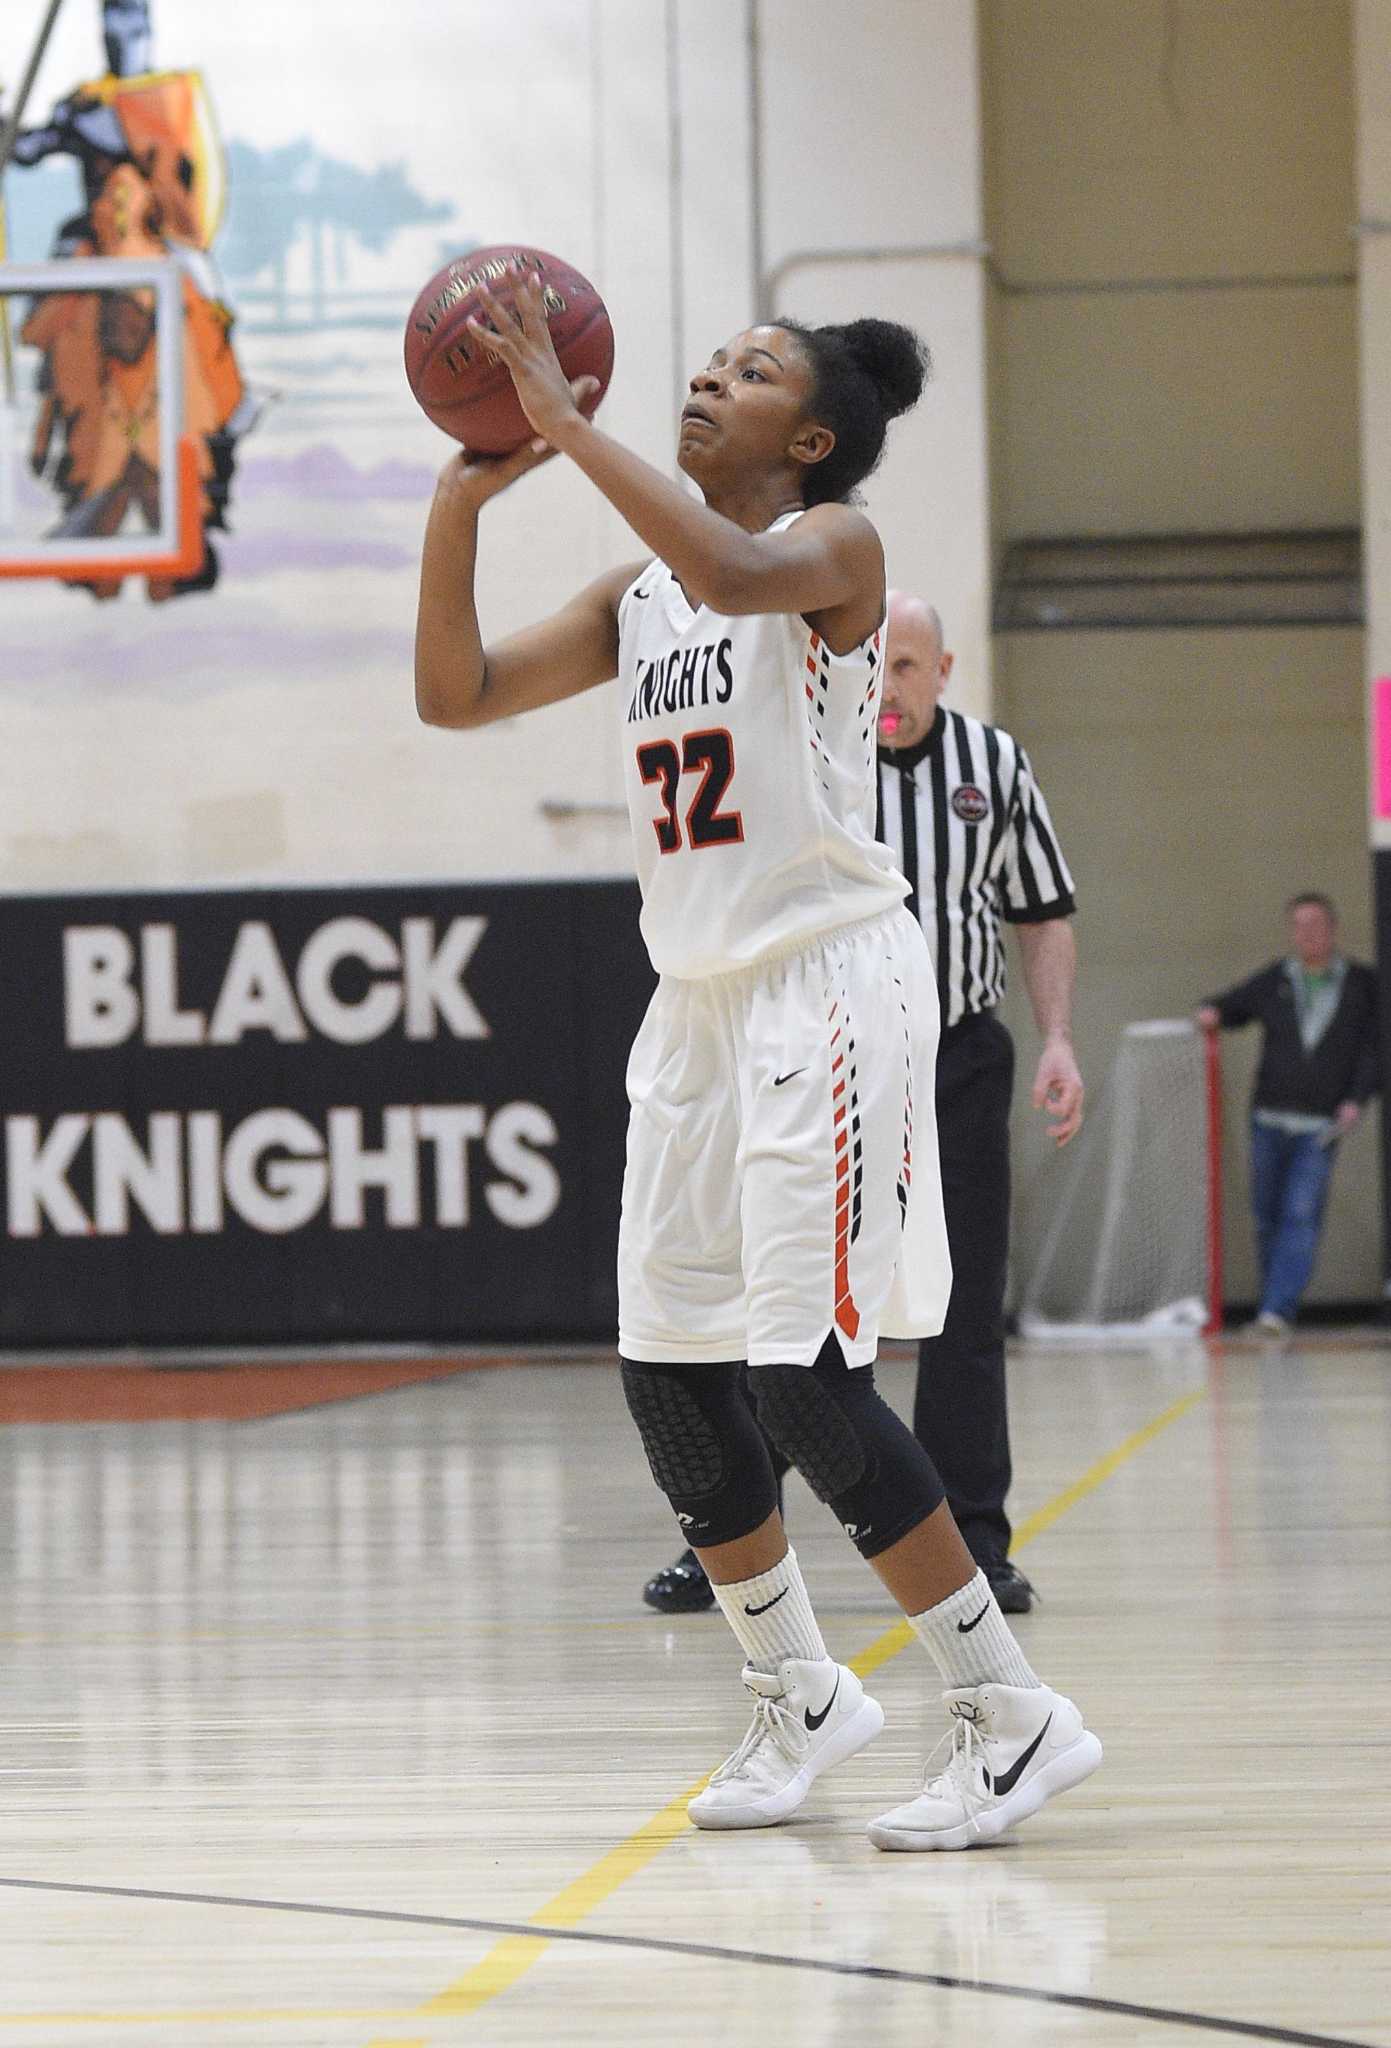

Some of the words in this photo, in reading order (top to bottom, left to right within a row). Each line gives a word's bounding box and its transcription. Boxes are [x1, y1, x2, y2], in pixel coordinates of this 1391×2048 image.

[636, 726, 745, 856] 32
[62, 914, 490, 1049] BLACK
[4, 1102, 561, 1238] KNIGHTS
